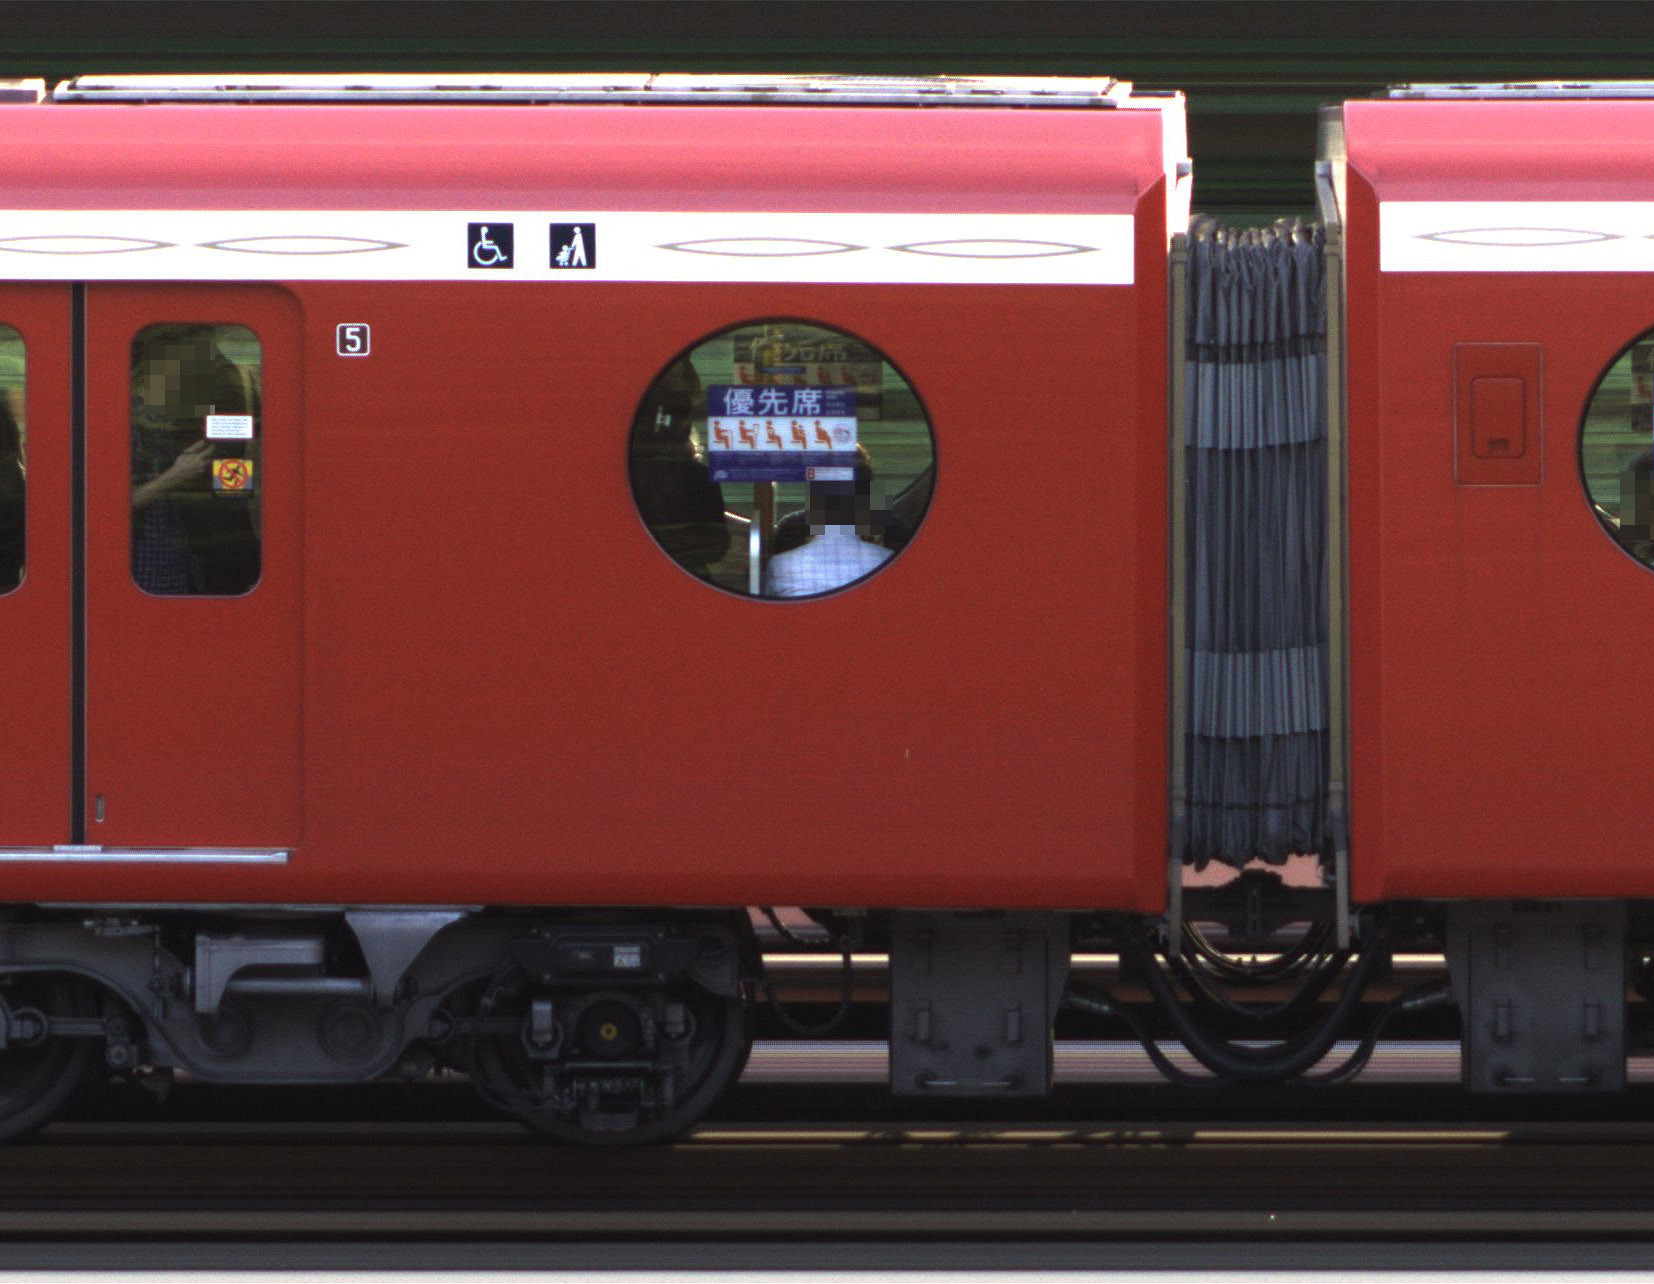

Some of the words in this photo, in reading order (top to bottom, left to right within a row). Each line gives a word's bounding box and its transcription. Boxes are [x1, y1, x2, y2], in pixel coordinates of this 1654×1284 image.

[345, 327, 361, 352] 5
[723, 387, 823, 416] 優先席
